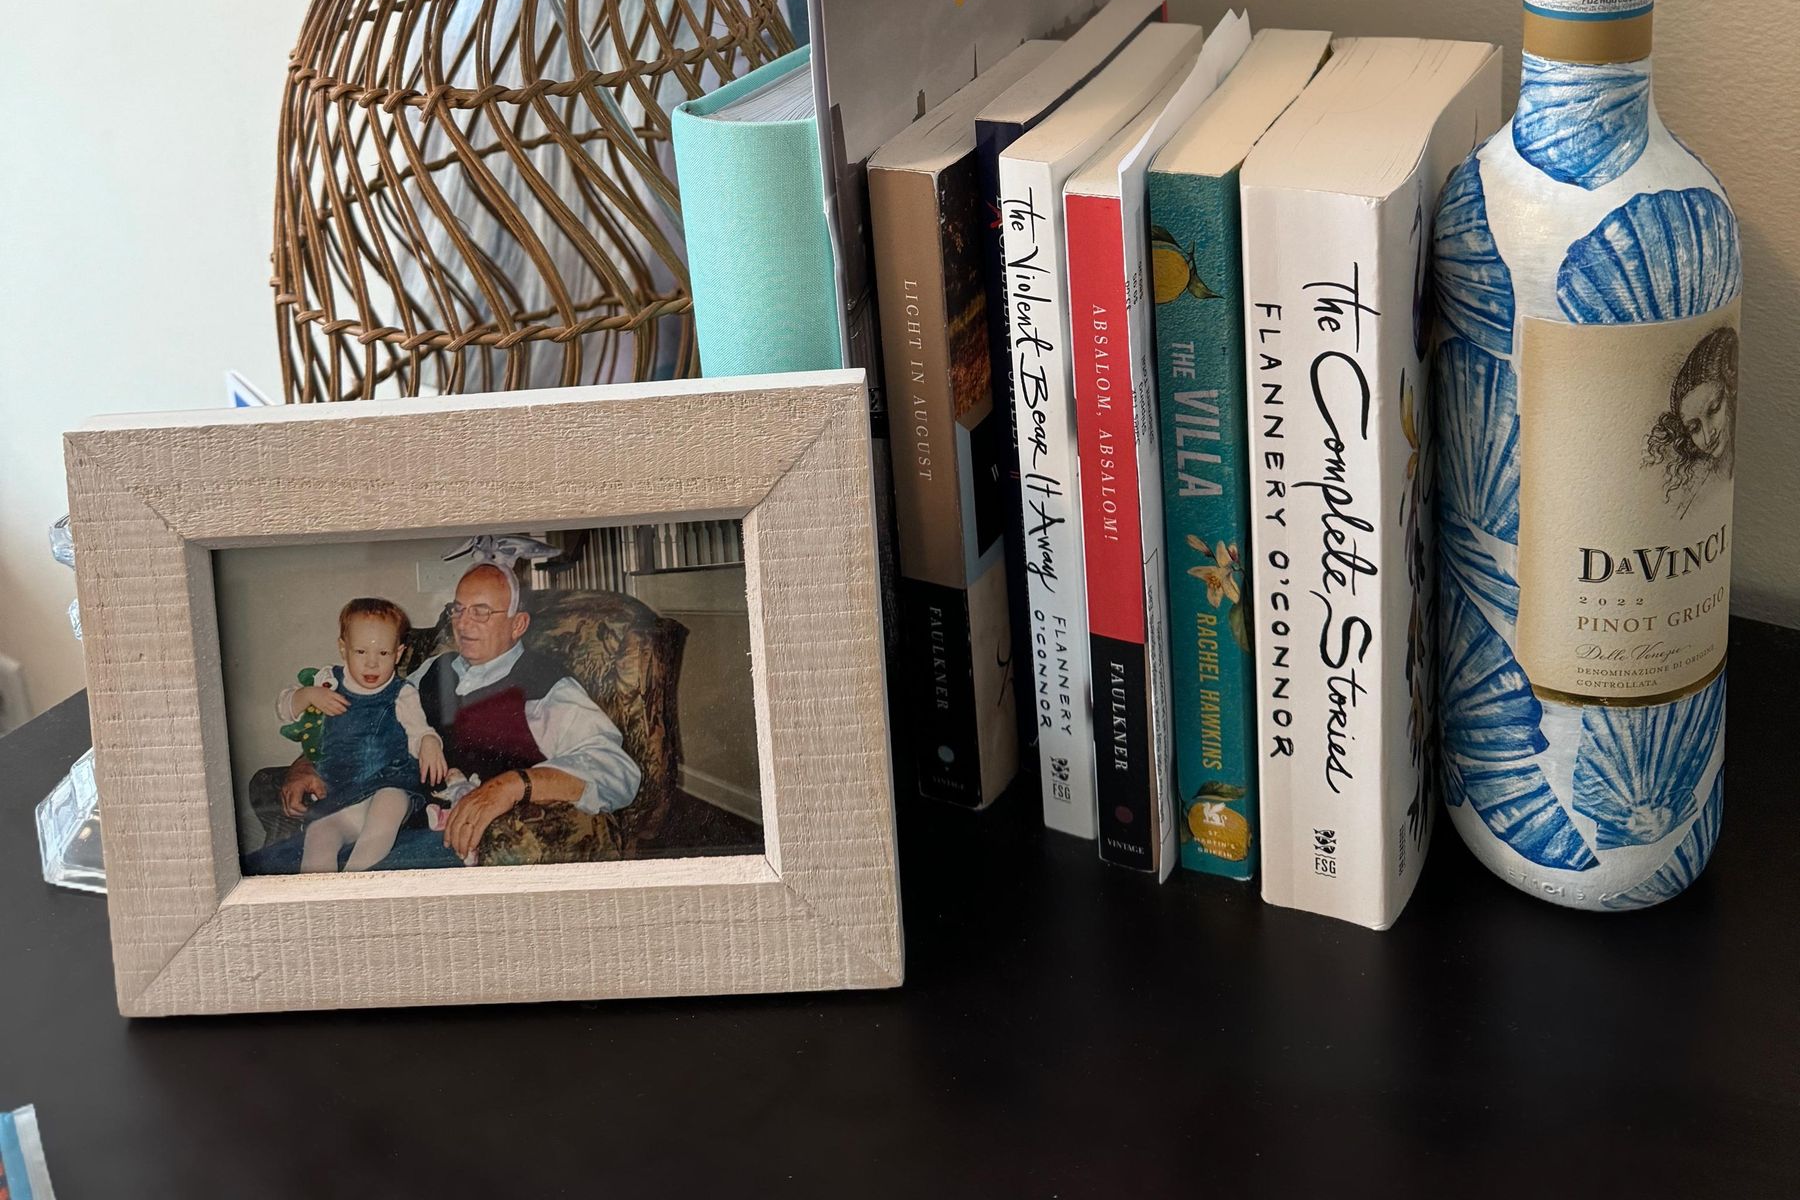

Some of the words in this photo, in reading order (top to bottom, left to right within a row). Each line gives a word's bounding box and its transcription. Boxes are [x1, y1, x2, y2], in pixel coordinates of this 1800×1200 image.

[1002, 186, 1047, 244] The
[904, 279, 923, 349] LIGHT
[1007, 246, 1052, 358] Violent
[1302, 260, 1382, 354] The
[910, 360, 925, 384] IN
[1092, 304, 1112, 417] ABSALOM,
[1171, 340, 1197, 381] THE
[913, 395, 932, 481] AUGUST
[1173, 389, 1224, 497] VILLA
[1254, 302, 1287, 528] FLANNERY
[1025, 473, 1064, 498] It
[1099, 428, 1119, 542] ABSALOM!
[1290, 350, 1379, 597] Complete
[1026, 499, 1066, 594] Away
[1577, 616, 1658, 633] PINOT
[1667, 586, 1724, 628] GRIGIO
[1578, 596, 1645, 607] 2022
[928, 605, 950, 711] FAULKNER
[1033, 608, 1053, 729] O'CONNOR
[1052, 614, 1073, 737] FLANNERY
[1197, 612, 1220, 683] RACHEL
[1267, 549, 1295, 759] O'CONNOR
[1576, 664, 1669, 677] DENOMINAZIONE
[1673, 659, 1683, 670] DI
[1576, 678, 1658, 689] CONTROLLATA
[1110, 660, 1129, 772] FAULKNER
[1200, 688, 1223, 771] HAWKINS
[1052, 782, 1071, 801] FSG
[1106, 836, 1145, 855] VINTAGE
[1314, 856, 1337, 875] FSG
